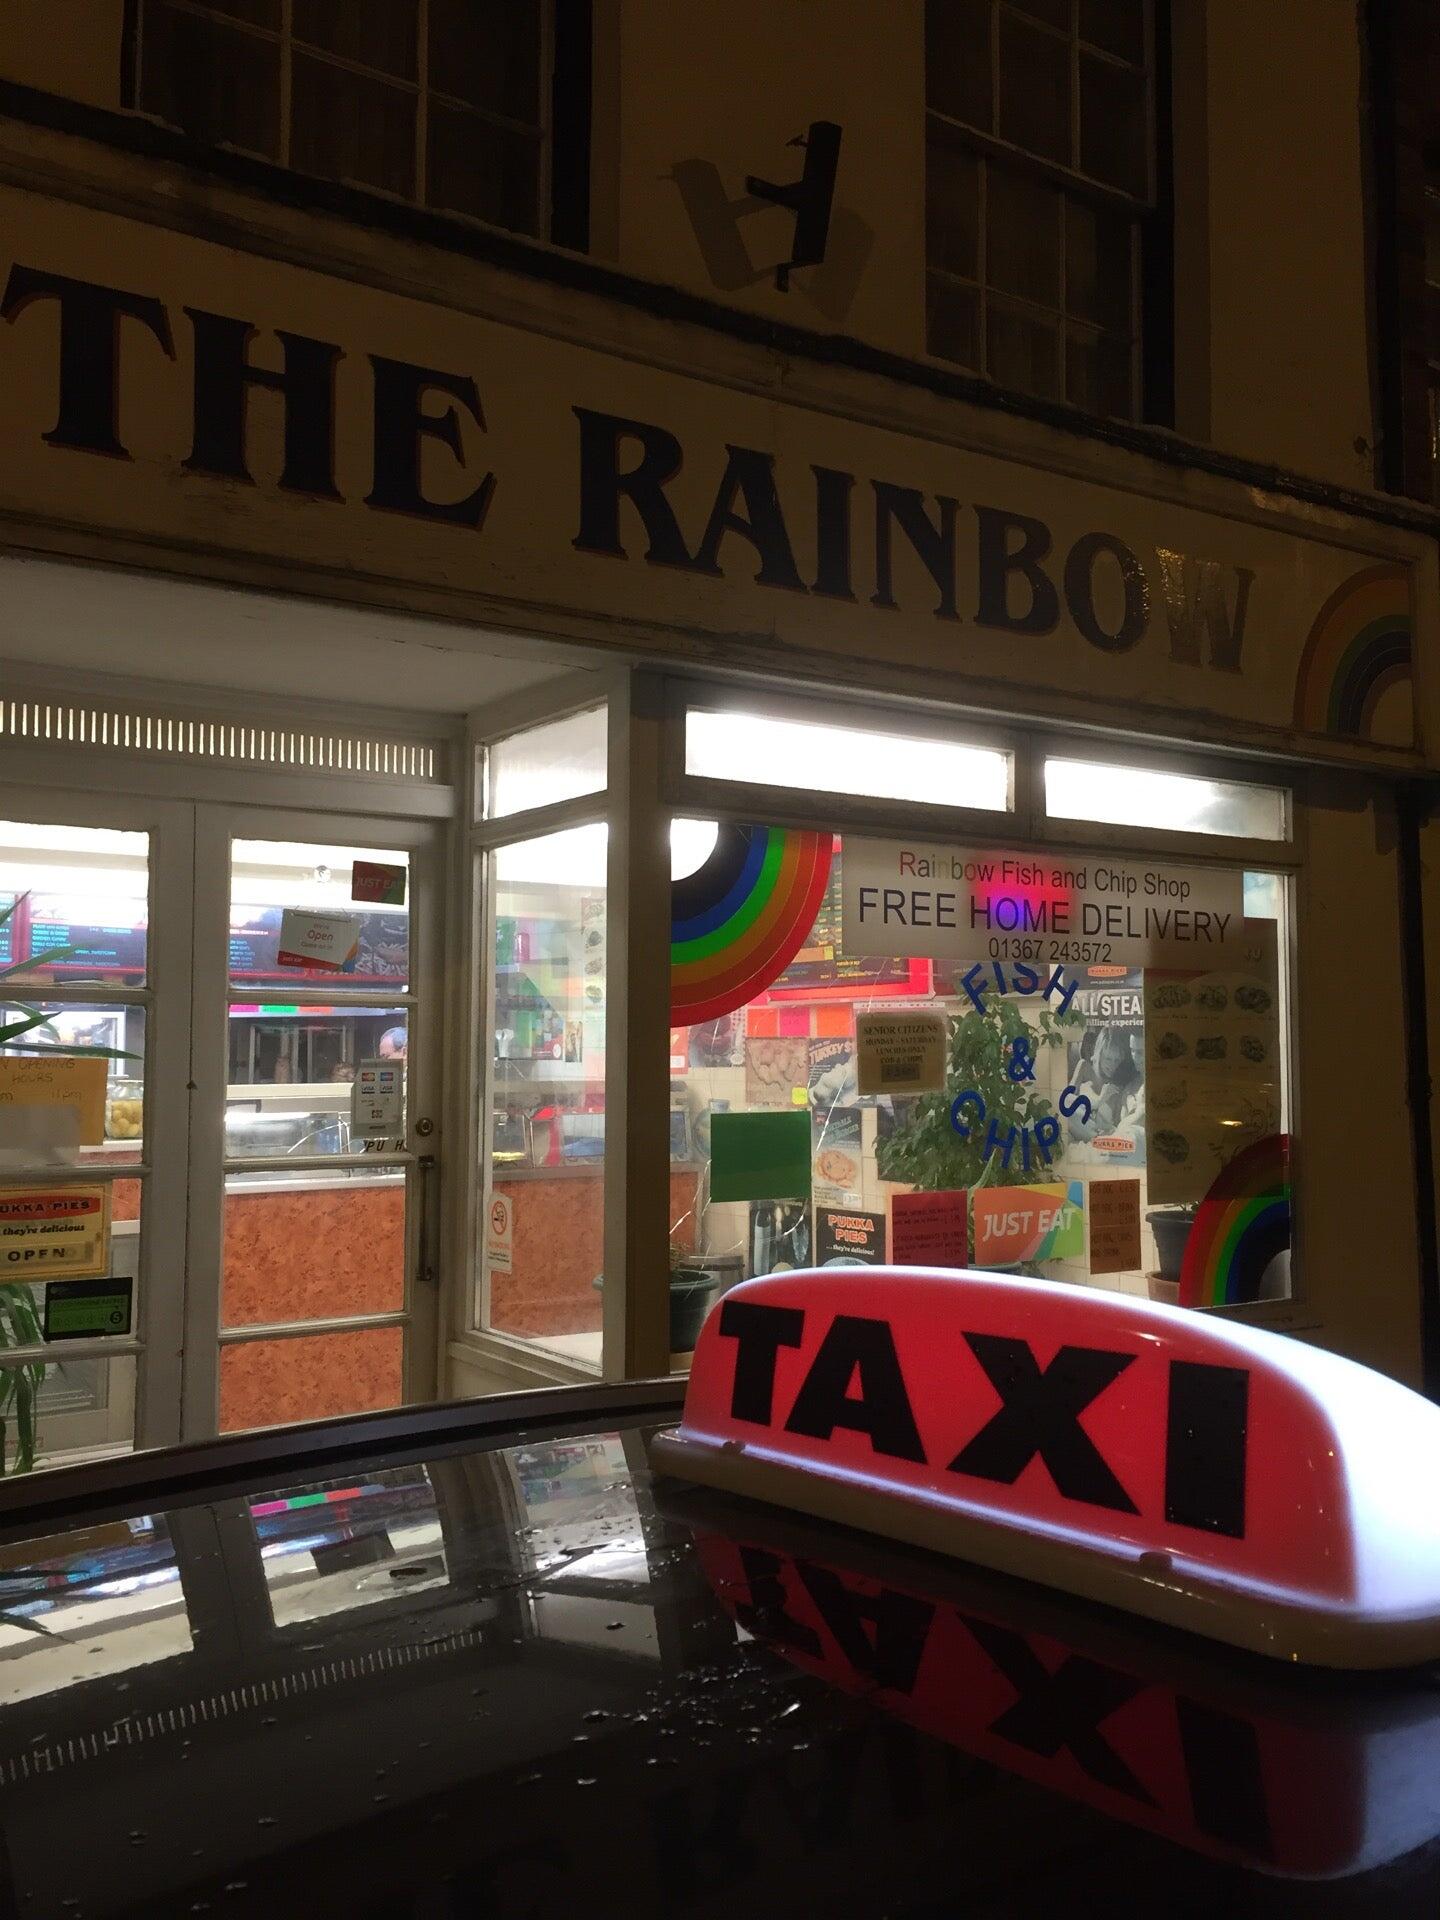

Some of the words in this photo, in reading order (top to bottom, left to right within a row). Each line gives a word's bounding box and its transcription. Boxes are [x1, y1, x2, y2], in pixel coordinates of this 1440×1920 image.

[0, 263, 496, 530] THE
[571, 406, 1255, 673] RAINBOW
[899, 852, 994, 883] Rainbow
[1002, 860, 1043, 888] Fish
[1051, 866, 1086, 890] and
[1095, 868, 1136, 896] Chip
[1144, 872, 1191, 903] Shop
[860, 887, 956, 928] FREE
[970, 895, 1070, 935] HOME
[1083, 903, 1231, 943] DELIVERY
[307, 929, 334, 941] Open
[989, 938, 1042, 960] 01367
[1050, 941, 1112, 963] 243572
[960, 961, 1079, 1017] FISH
[1101, 995, 1142, 1016] STEA
[863, 1025, 896, 1036] SENIOR
[897, 1024, 938, 1034] CITIZENS
[18, 1058, 76, 1070] OPENING
[1008, 1037, 1036, 1082] &
[12, 1072, 53, 1084] HOURS
[950, 1085, 1091, 1172] CHIPS
[365, 1140, 404, 1152] PUH
[0, 1203, 44, 1213] UKKA
[53, 1201, 90, 1210] PIES
[40, 1224, 85, 1234] delicious
[828, 1214, 875, 1231] PUKKA
[982, 1211, 1033, 1242] JUST
[1037, 1207, 1073, 1233] EAT
[835, 1229, 868, 1244] PIES
[8, 1248, 65, 1262] OPEN
[719, 1302, 1249, 1539] TAXI
